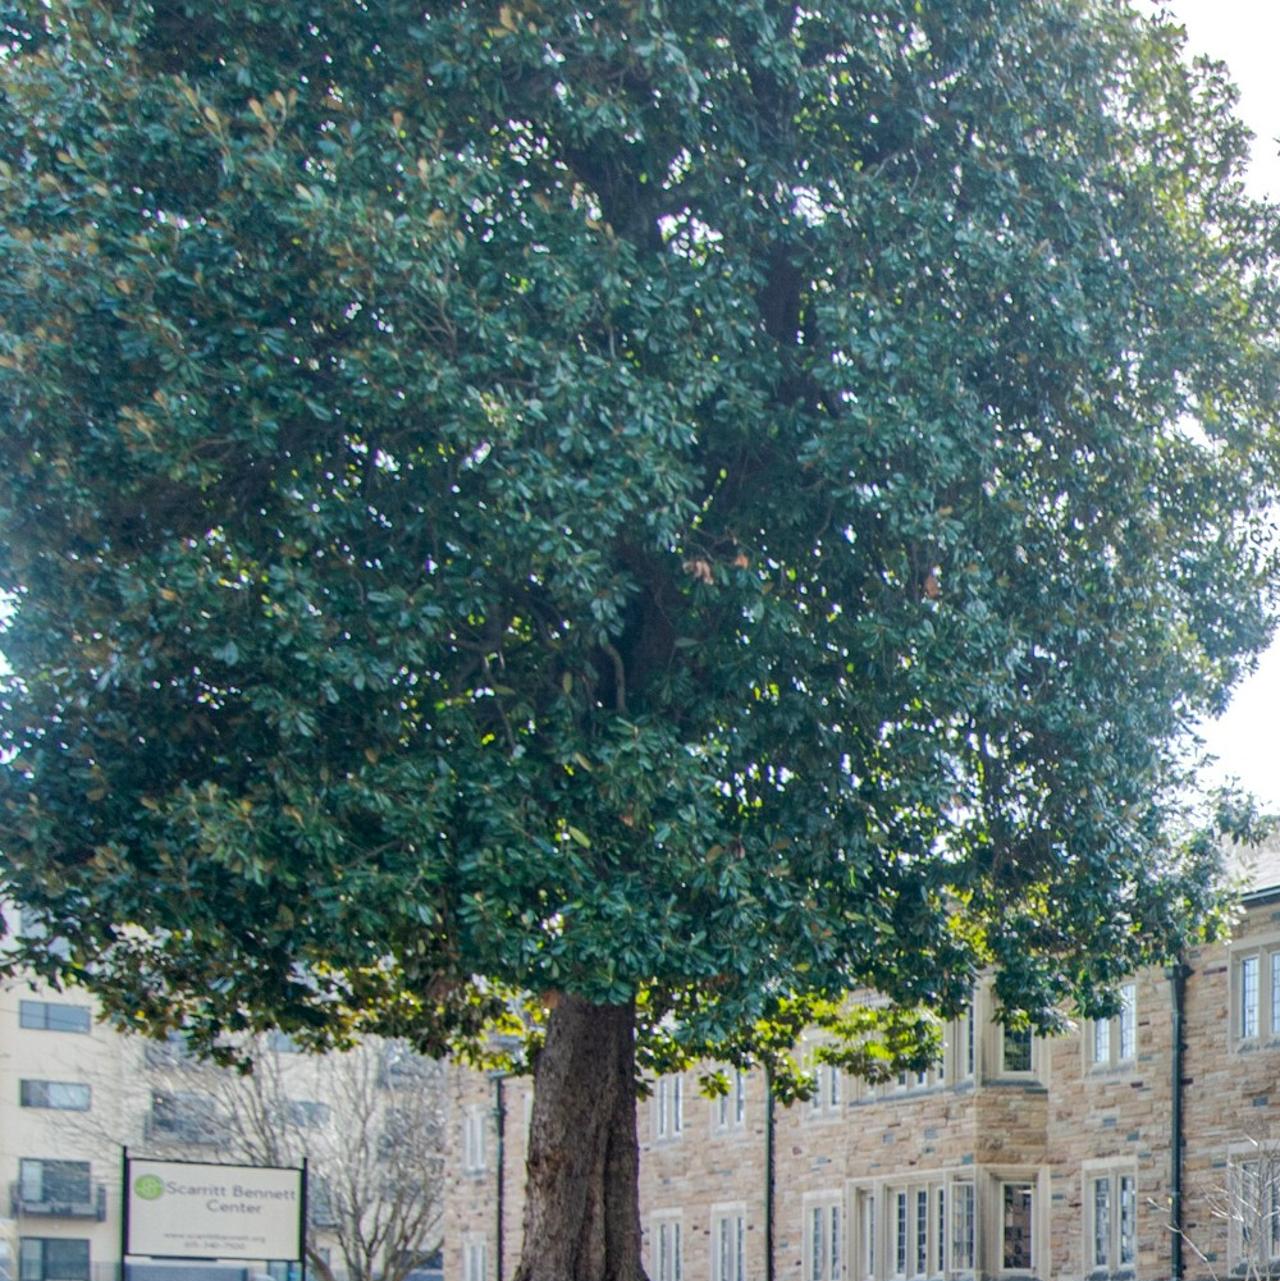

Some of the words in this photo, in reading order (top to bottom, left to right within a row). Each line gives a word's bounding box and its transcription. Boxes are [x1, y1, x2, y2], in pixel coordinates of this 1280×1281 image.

[166, 1181, 226, 1196] Scarritt
[233, 1184, 296, 1199] Bennett
[206, 1199, 262, 1213] Center
